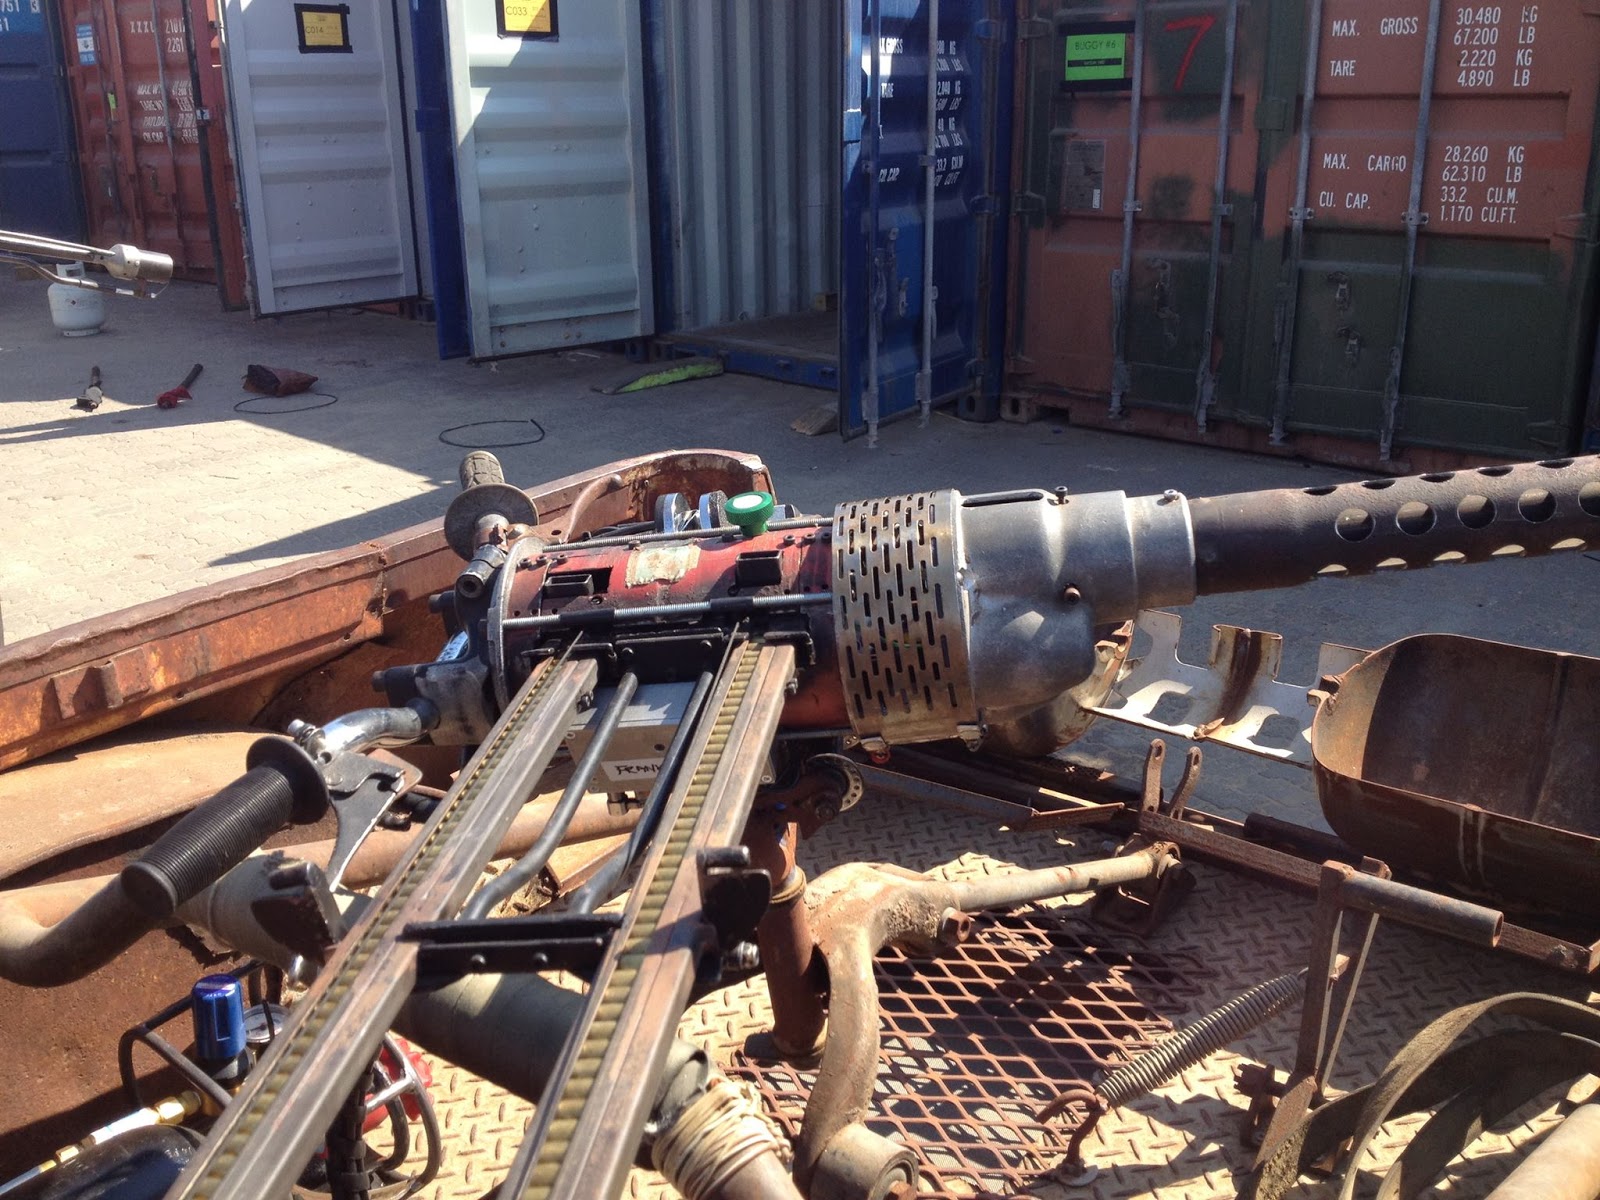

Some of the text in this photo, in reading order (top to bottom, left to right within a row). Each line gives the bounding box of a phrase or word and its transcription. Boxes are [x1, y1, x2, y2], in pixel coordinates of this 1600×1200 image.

[505, 6, 527, 16] C033
[1456, 5, 1538, 25] 30.480 KG
[304, 26, 324, 35] C014
[1332, 17, 1418, 36] MAX. GROSS
[1075, 40, 1104, 50] BUGGY
[1453, 27, 1536, 45] 67.200 LB
[1164, 14, 1216, 91] 7
[1460, 49, 1533, 67] 2.220 KG
[1330, 60, 1356, 76] TARE
[1457, 69, 1530, 87] 4.890 LB
[1323, 153, 1407, 172] MAX. CARGO
[1444, 146, 1525, 163] 28.260 KG
[1442, 166, 1522, 183] 62.310 LB
[1319, 191, 1371, 210] CU. CAP.
[1440, 186, 1519, 204] 33.2 CU.M.
[1440, 205, 1473, 222] 1.170
